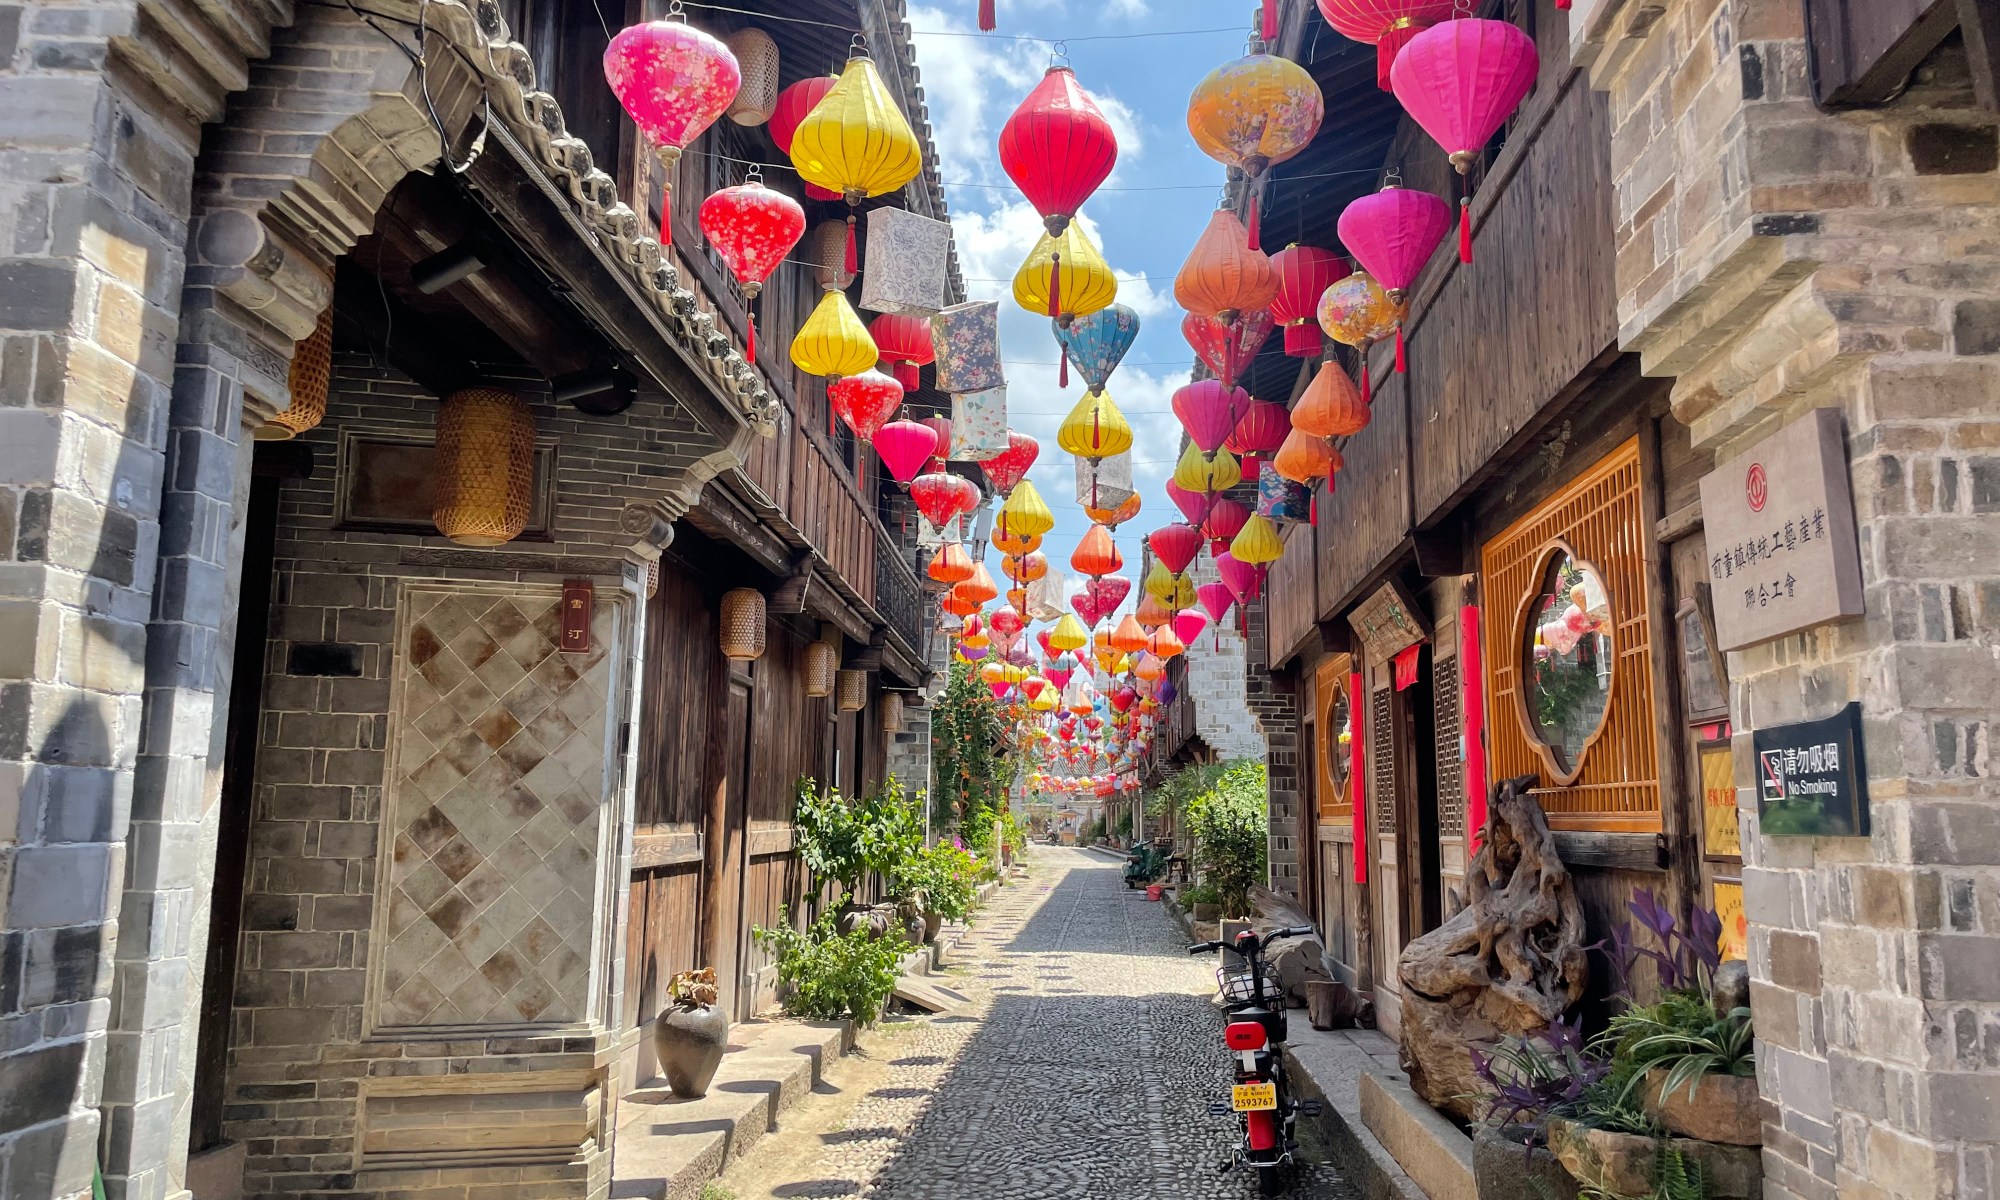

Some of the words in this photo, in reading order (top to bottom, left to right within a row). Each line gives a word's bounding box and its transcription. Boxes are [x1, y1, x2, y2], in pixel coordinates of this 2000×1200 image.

[1783, 743, 1839, 775] 请勿吸烟
[1788, 780, 1799, 795] No
[1800, 778, 1837, 796] Smoking
[1235, 1097, 1273, 1107] 2593767
